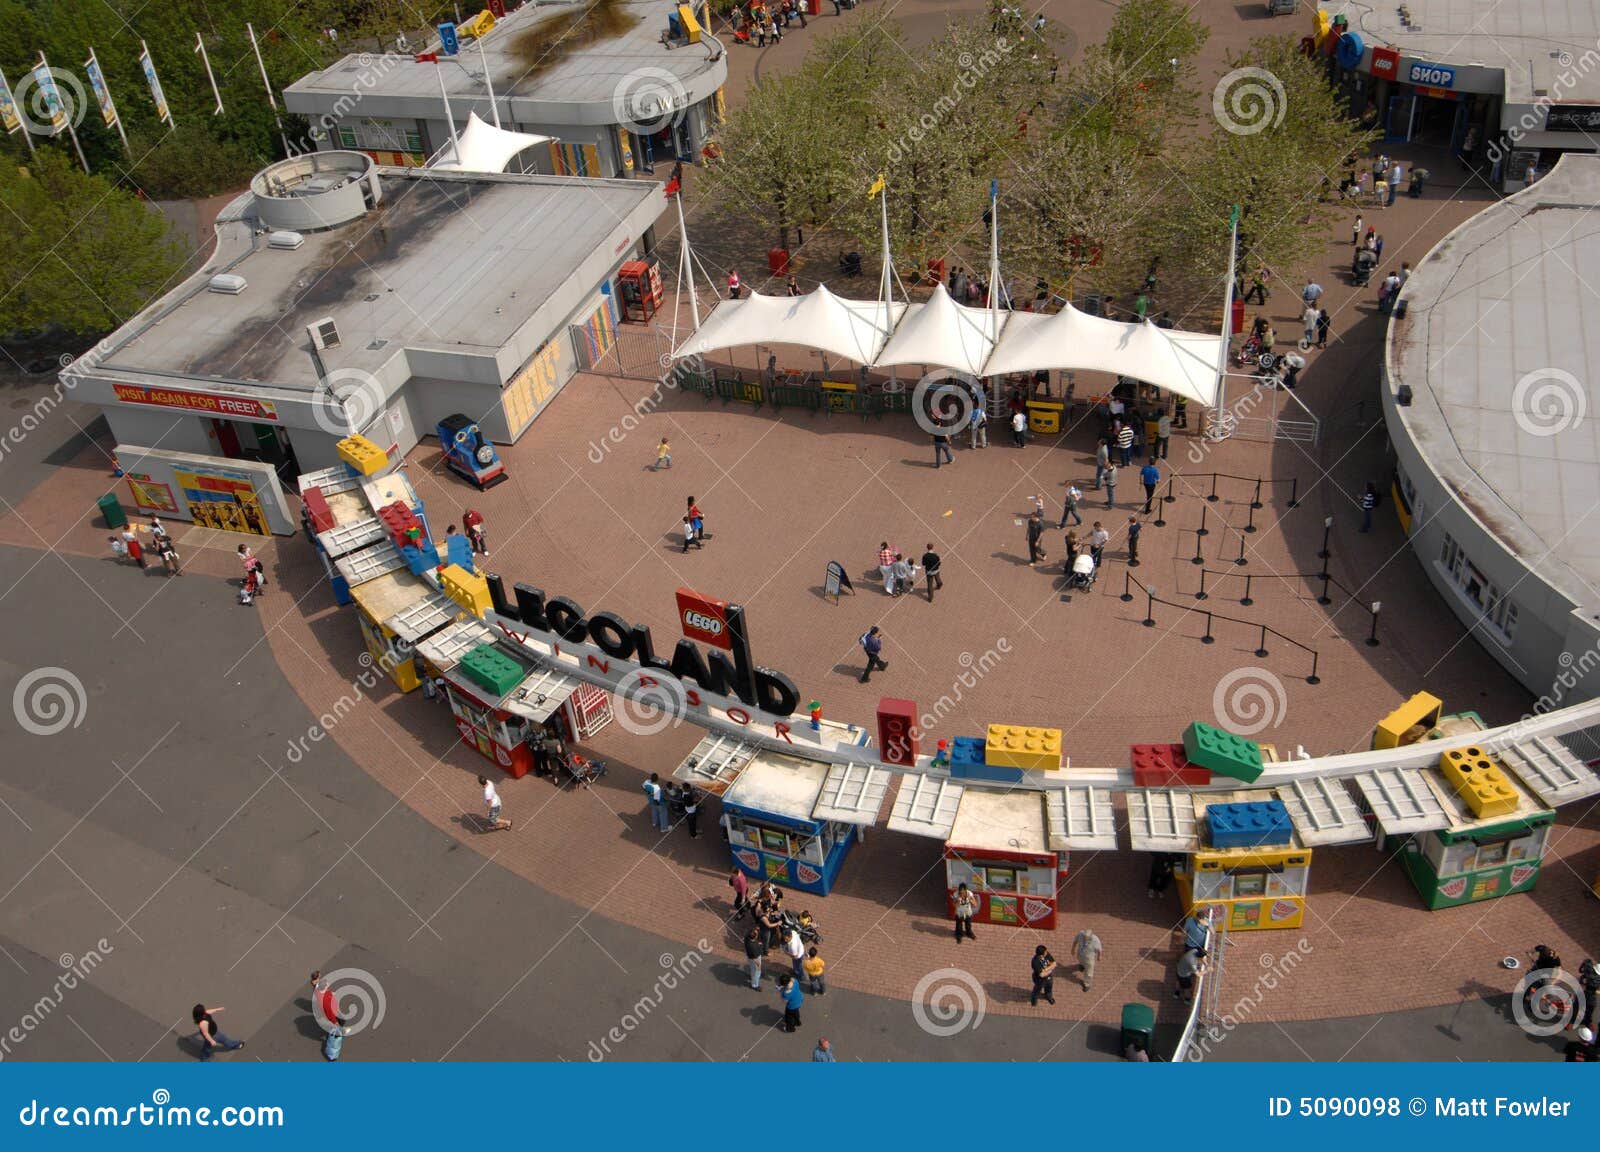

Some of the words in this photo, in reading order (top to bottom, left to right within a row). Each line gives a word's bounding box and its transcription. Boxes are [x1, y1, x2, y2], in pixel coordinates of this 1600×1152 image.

[1375, 59, 1393, 70] LEGO
[1411, 66, 1452, 85] SHOP
[116, 387, 147, 401] VISIT
[151, 392, 189, 407] AGAIN
[190, 396, 217, 409] FOR
[684, 608, 722, 634] LEGO
[485, 572, 800, 716] LEGOLAND
[496, 620, 793, 744] WINDSOR
